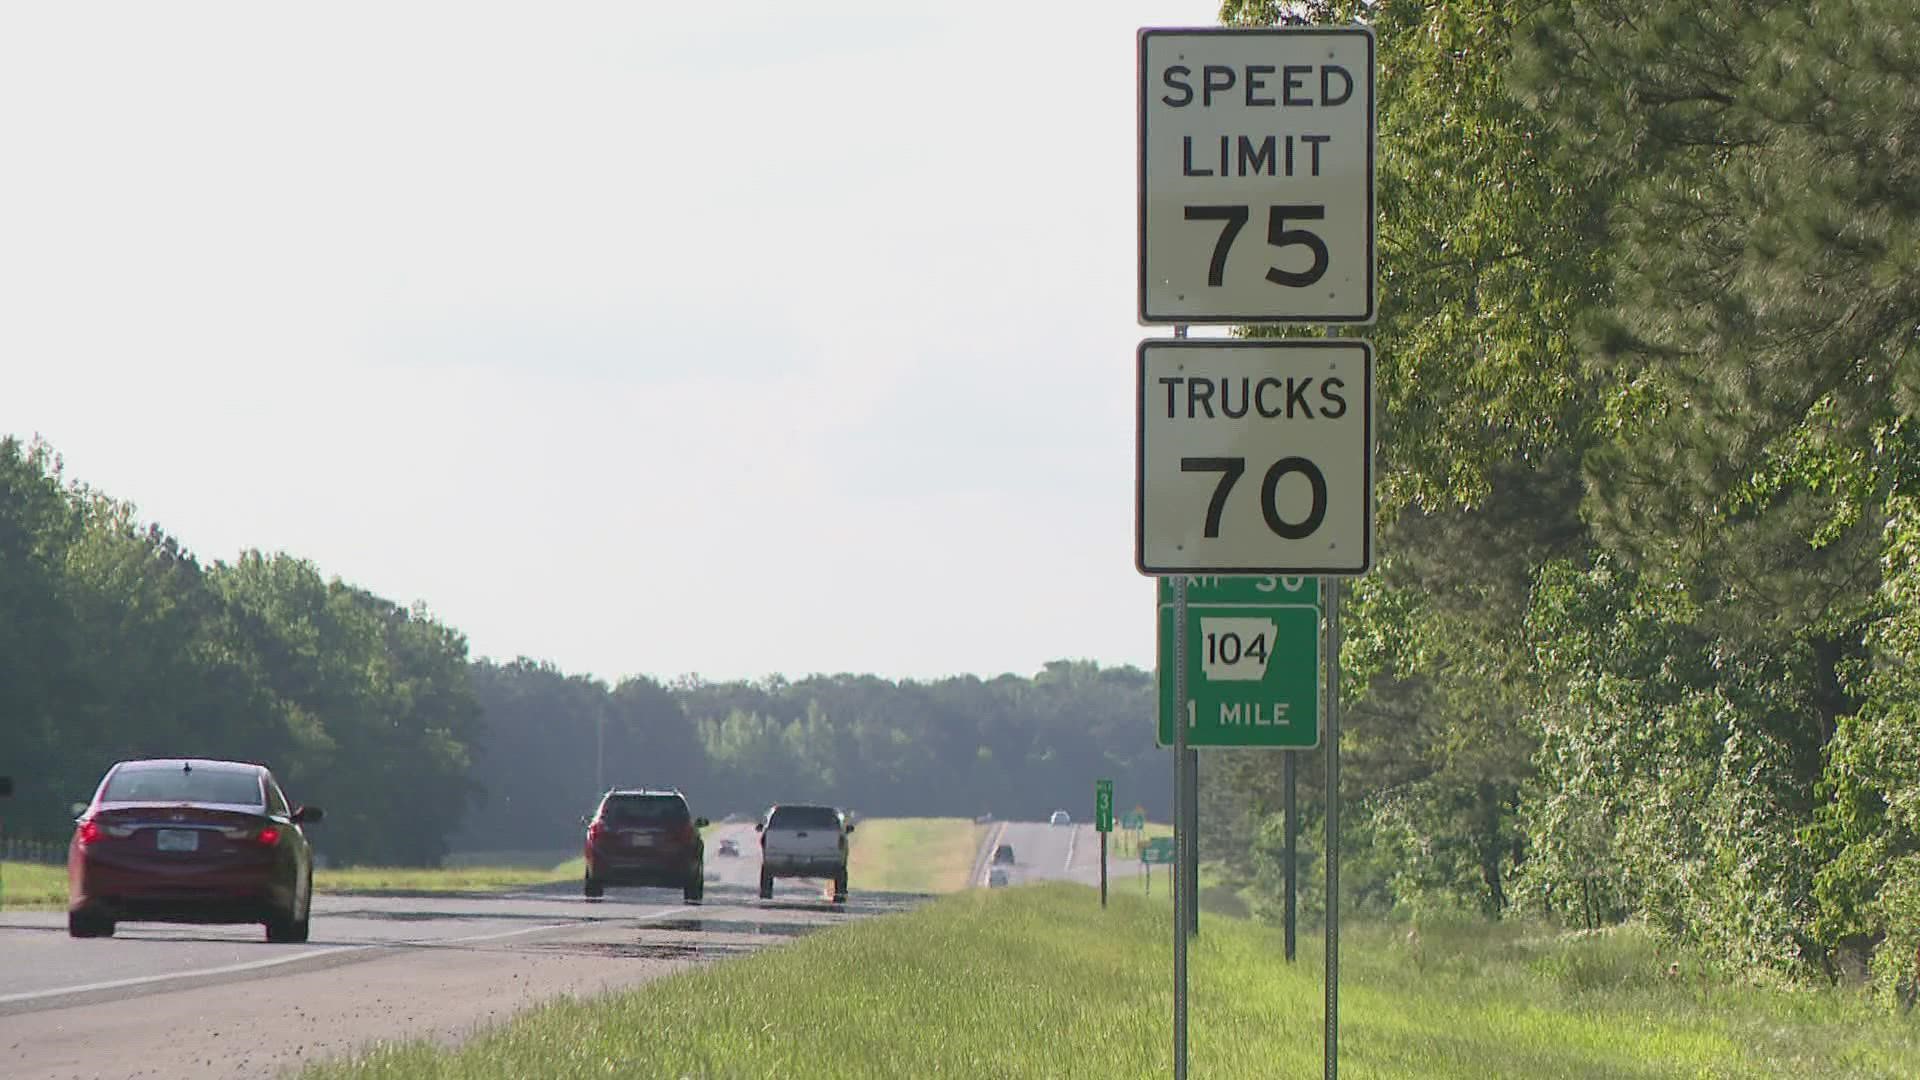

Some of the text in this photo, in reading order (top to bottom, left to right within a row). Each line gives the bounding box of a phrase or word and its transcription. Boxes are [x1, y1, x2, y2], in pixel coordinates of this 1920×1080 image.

[1162, 65, 1354, 107] SPEED
[1183, 135, 1331, 177] LIMIT
[1184, 205, 1329, 288] 75
[1158, 377, 1347, 418] TRUCKS
[1180, 456, 1328, 540] 70
[1207, 632, 1267, 665] 104
[1187, 699, 1290, 728] 1 MILE
